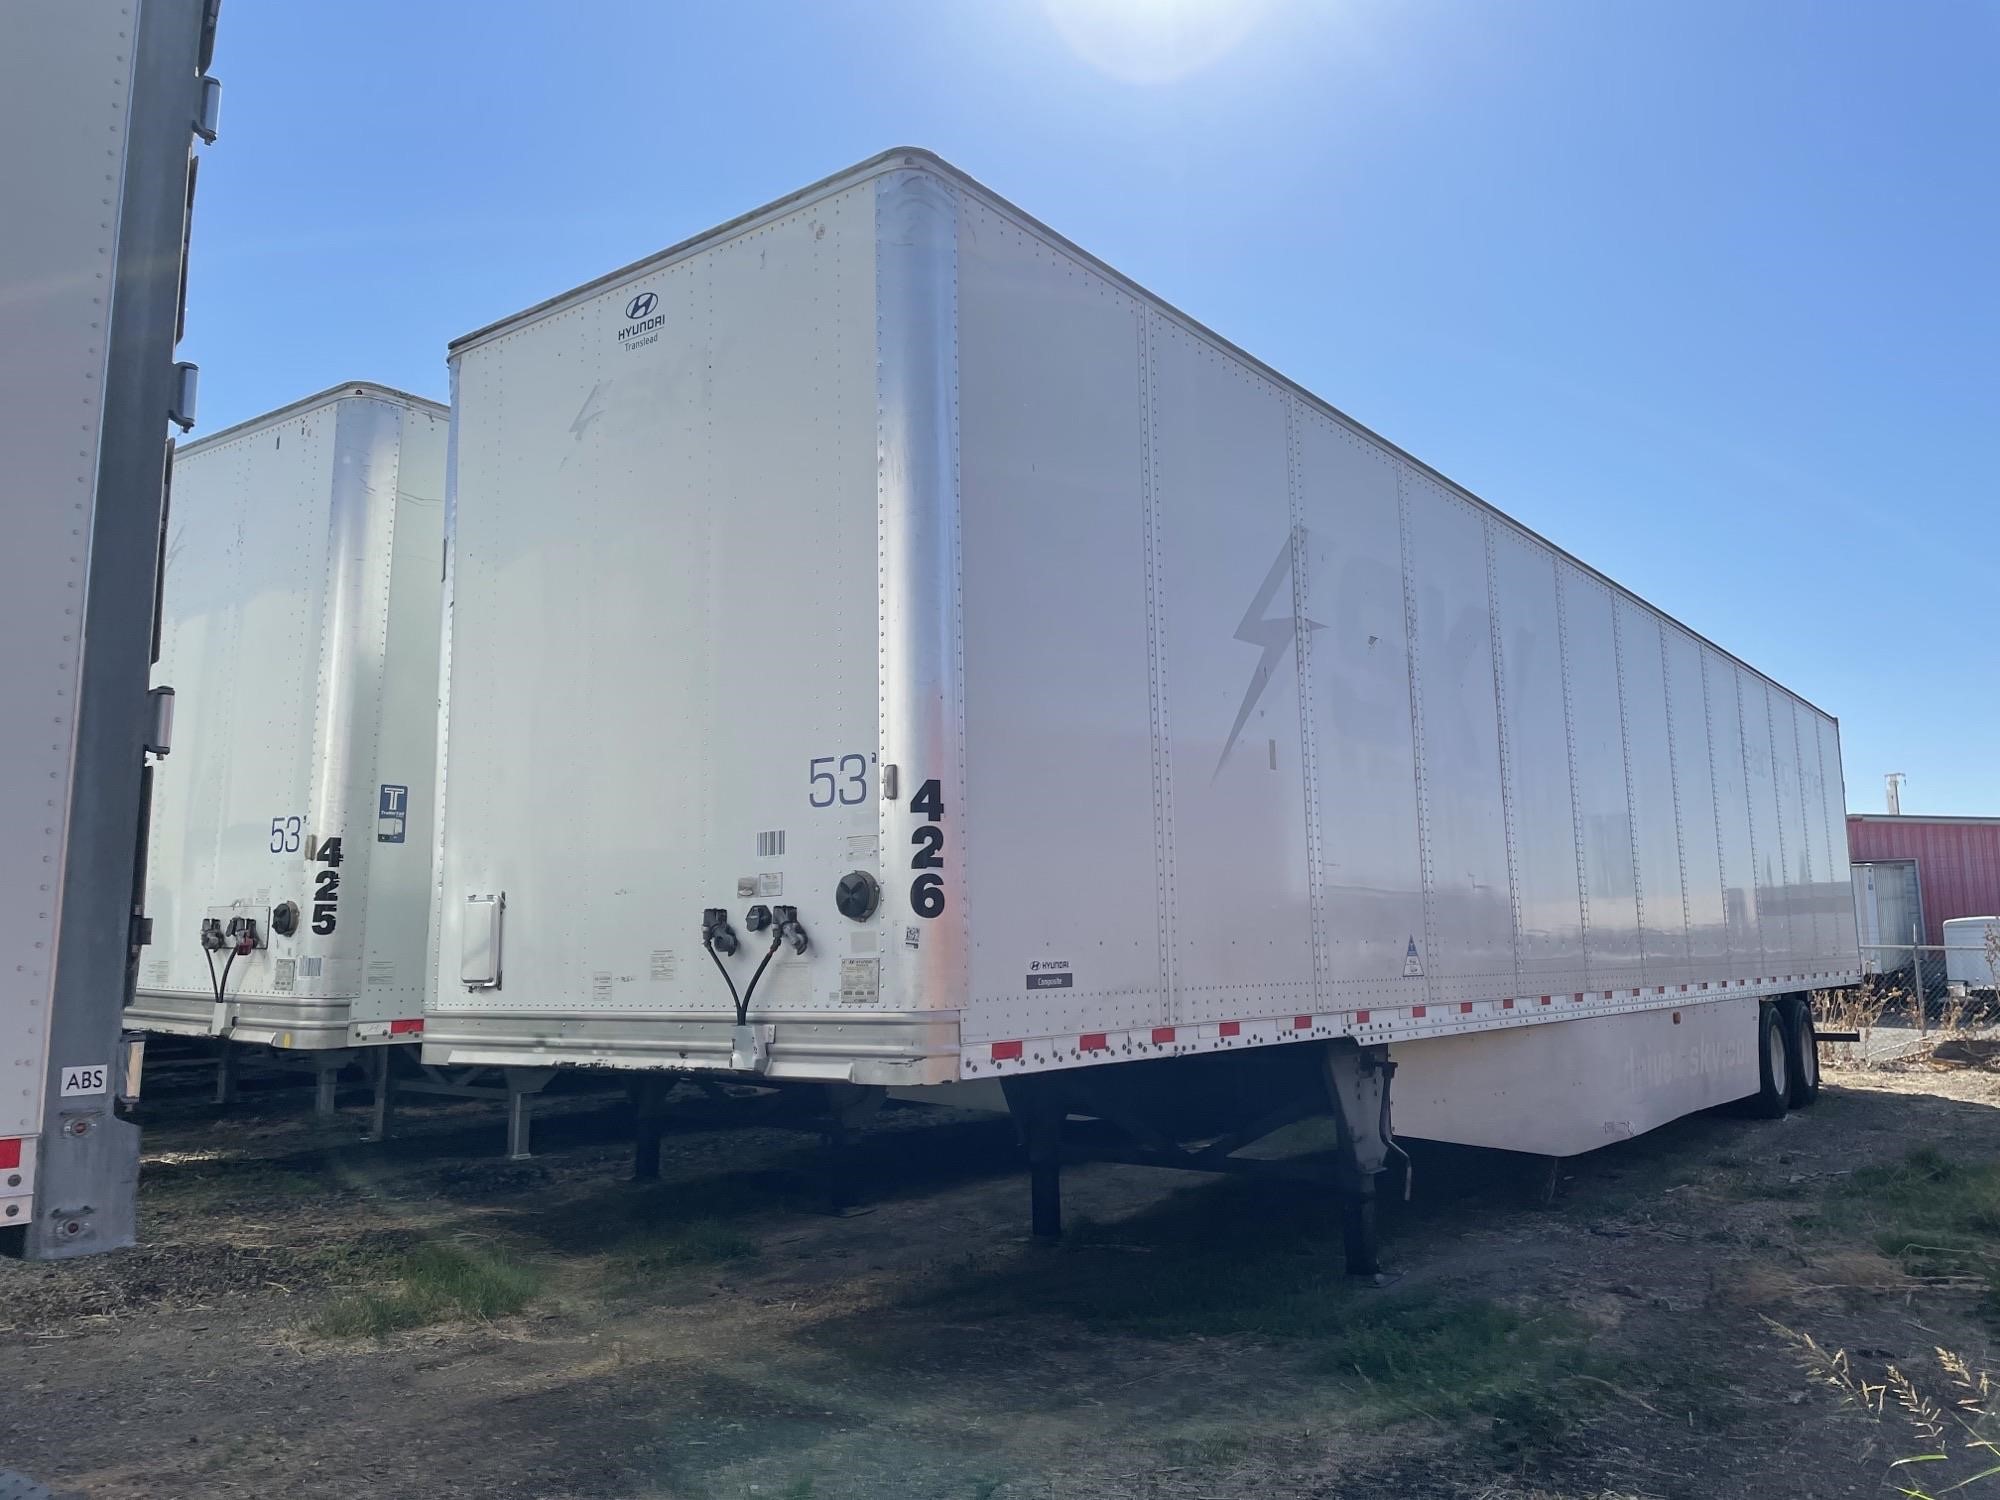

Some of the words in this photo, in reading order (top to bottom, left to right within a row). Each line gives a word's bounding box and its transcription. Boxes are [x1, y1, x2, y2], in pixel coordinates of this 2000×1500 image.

[618, 314, 665, 341] HYUNDAI
[624, 334, 659, 352] Translead
[910, 779, 945, 919] 426
[312, 837, 344, 935] 425
[1042, 961, 1070, 969] HYUNDAI
[1038, 977, 1063, 986] Composite
[65, 1070, 104, 1091] ABS
